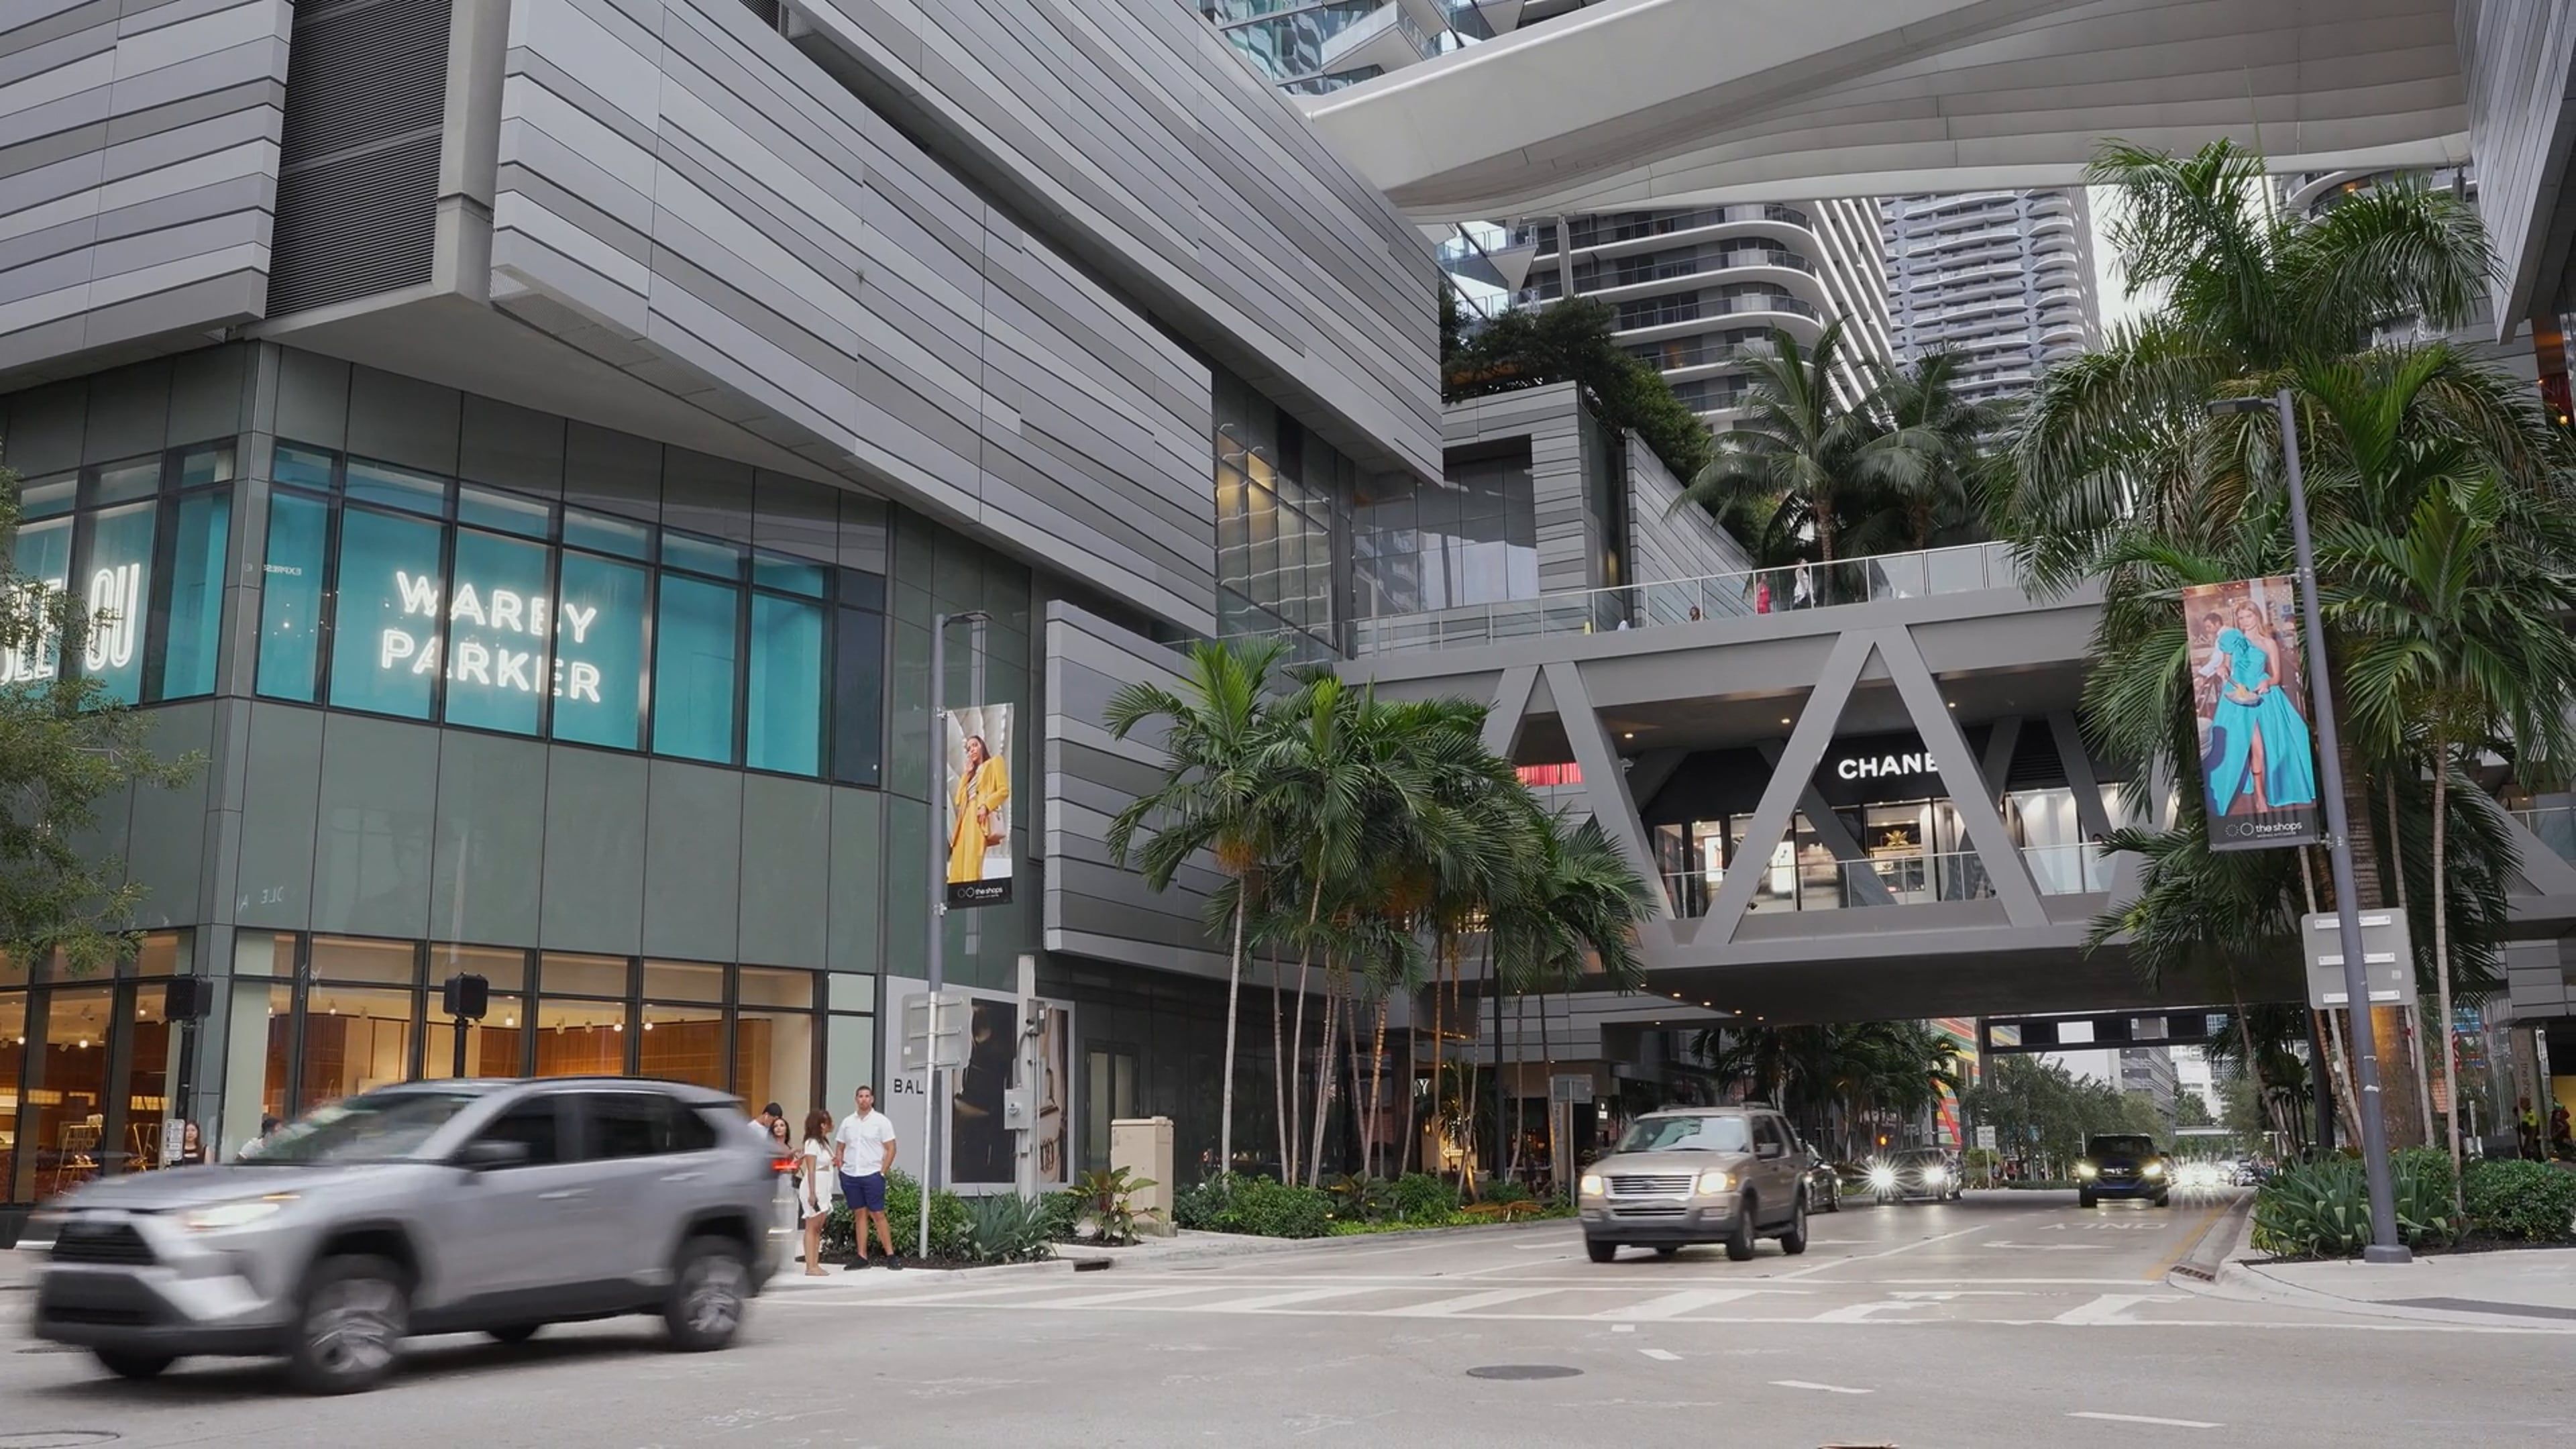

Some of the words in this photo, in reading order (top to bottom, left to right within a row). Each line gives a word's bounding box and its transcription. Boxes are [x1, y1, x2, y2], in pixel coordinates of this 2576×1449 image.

[85, 564, 140, 669] OU
[381, 629, 600, 702] PARKER
[1838, 753, 1938, 779] CHANE
[2273, 822, 2302, 832] shops
